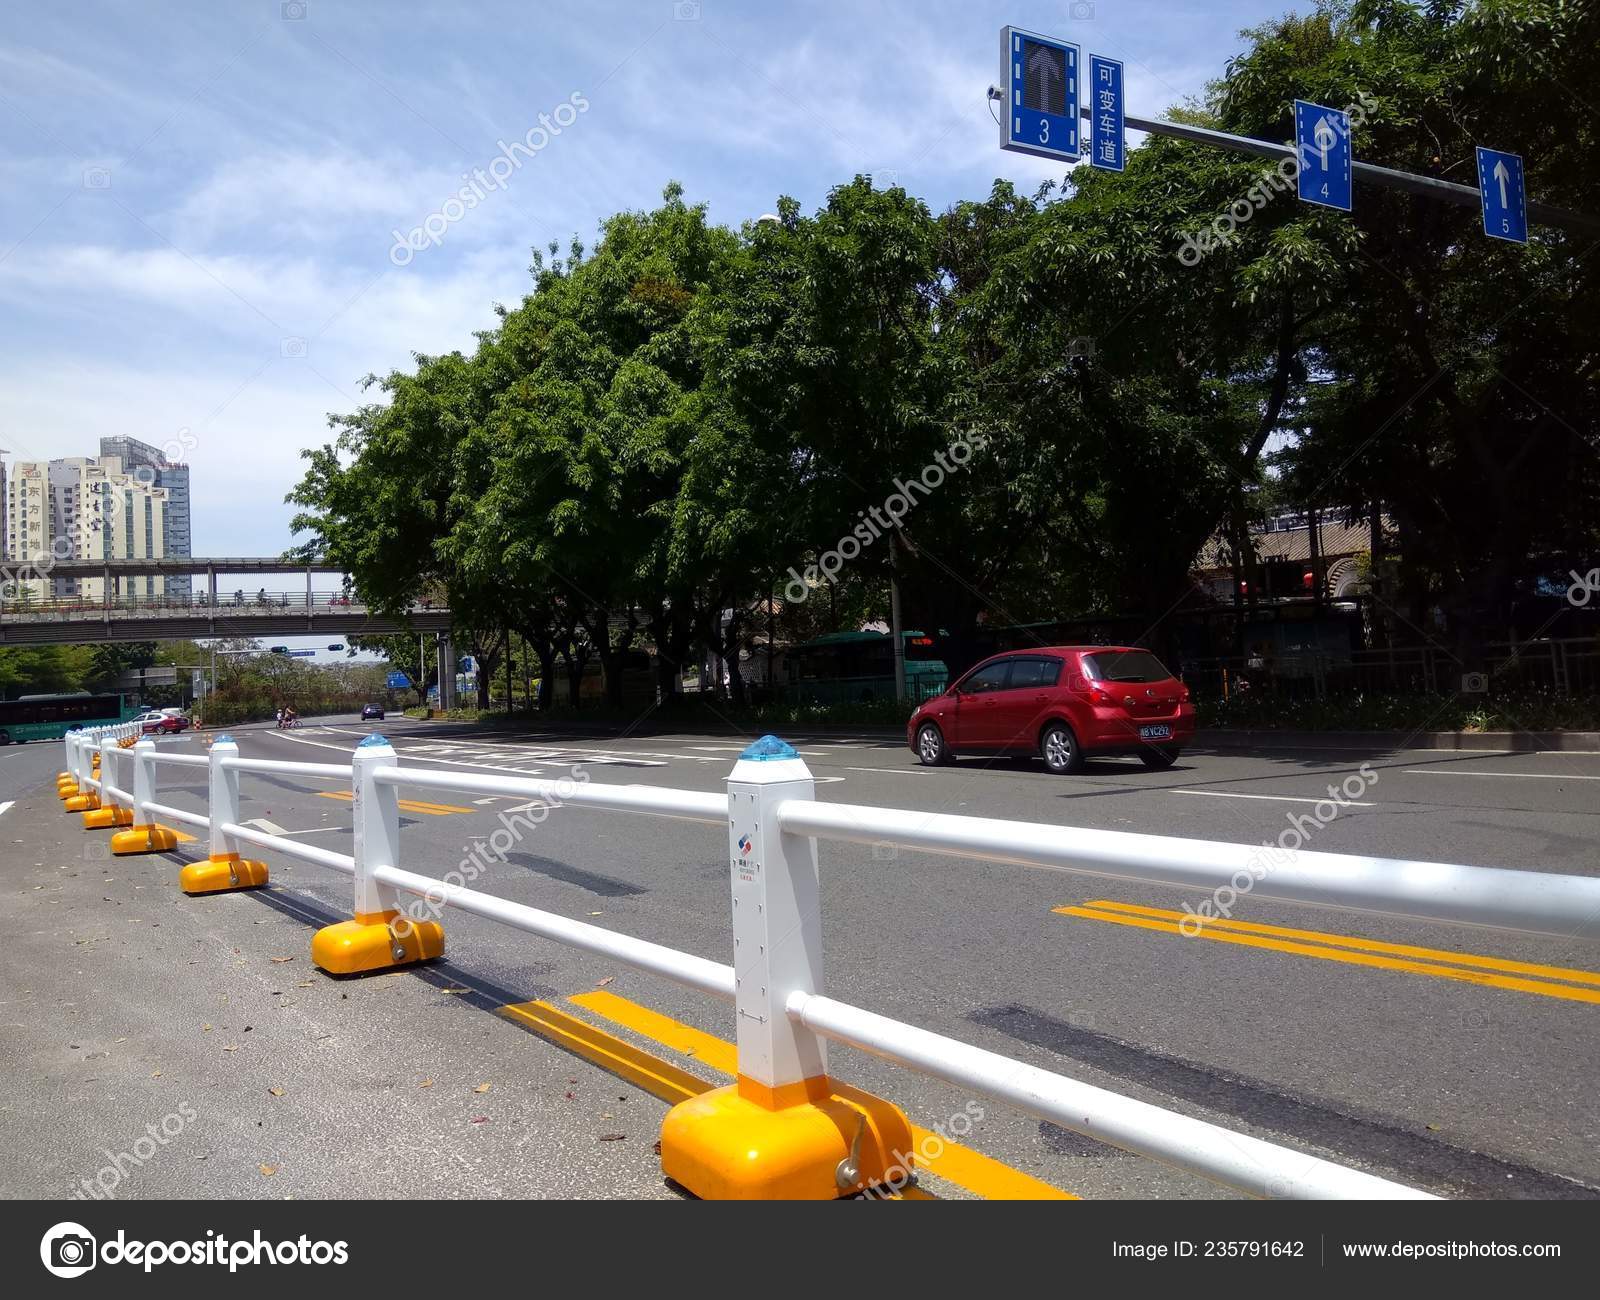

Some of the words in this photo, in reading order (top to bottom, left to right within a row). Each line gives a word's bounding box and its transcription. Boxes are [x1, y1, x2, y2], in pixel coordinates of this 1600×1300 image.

[1098, 63, 1117, 163] 可变车道
[1039, 119, 1050, 144] 3
[1320, 182, 1330, 199] 4
[1502, 218, 1510, 234] 5
[28, 486, 41, 550] 东方新地
